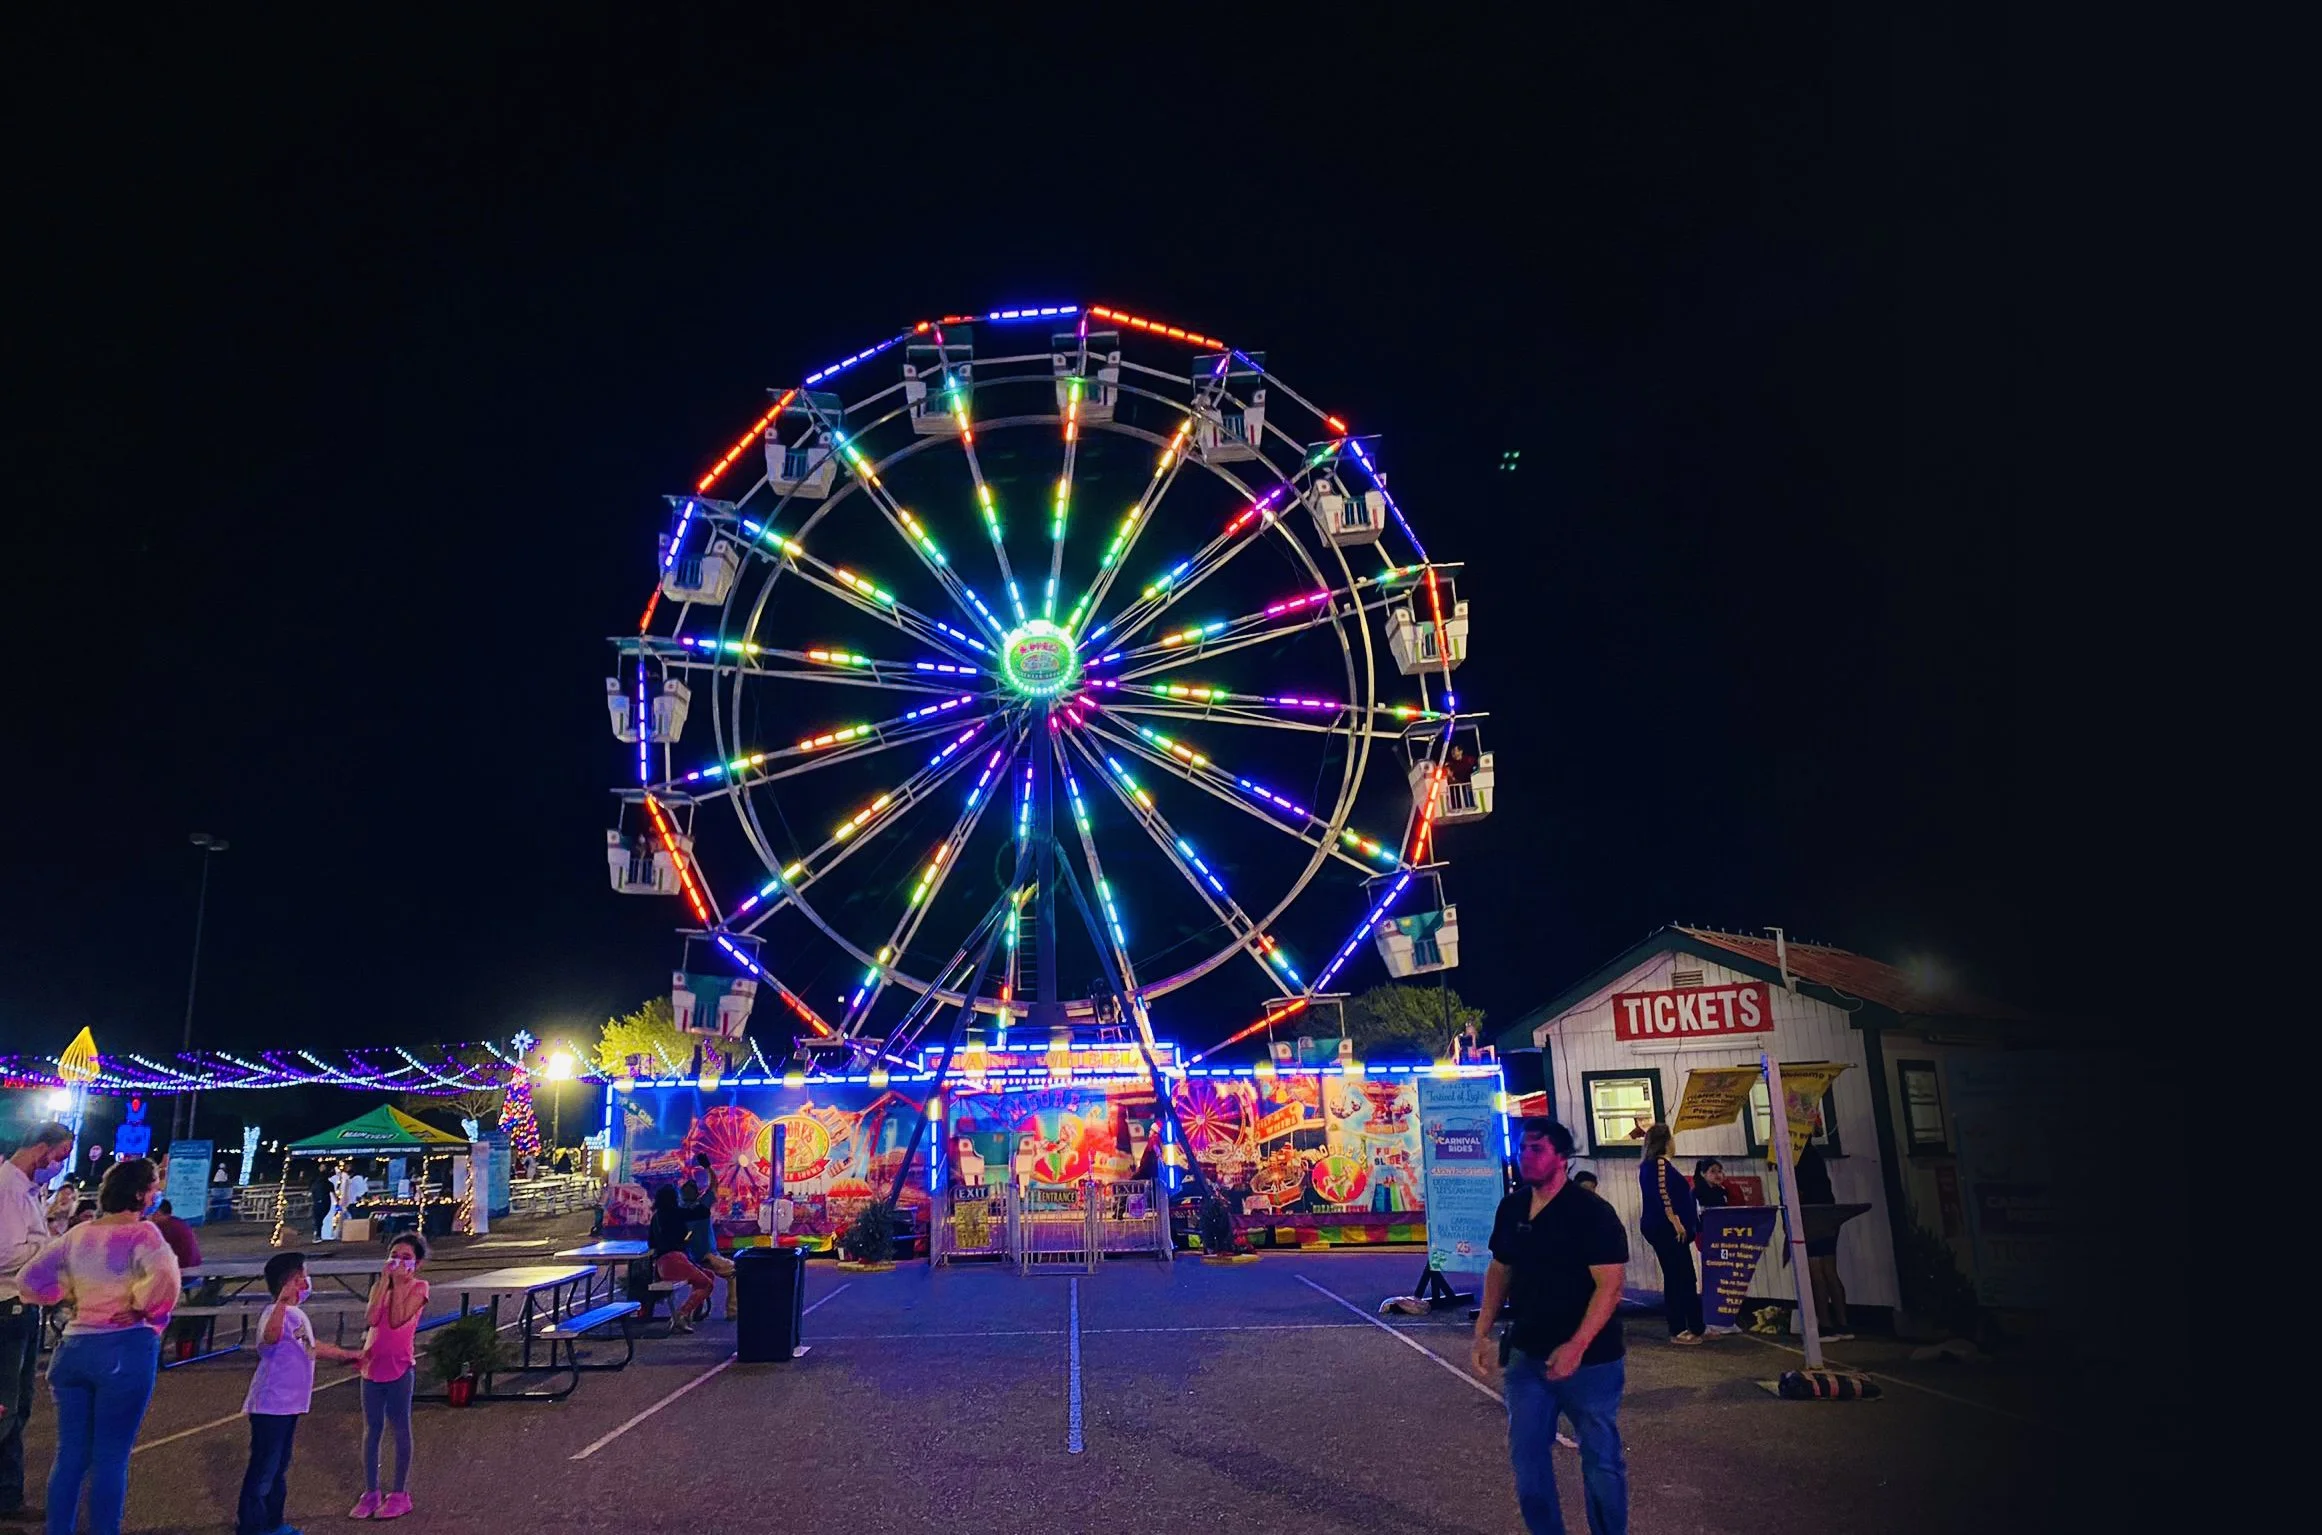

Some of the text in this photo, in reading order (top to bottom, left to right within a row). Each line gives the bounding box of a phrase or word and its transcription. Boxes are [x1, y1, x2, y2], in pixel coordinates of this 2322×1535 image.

[1623, 988, 1761, 1034] TICKETS
[1044, 1051, 1140, 1068] WHEEL
[1266, 1114, 1298, 1135] WHIRL
[1439, 1137, 1480, 1145] CARNIVAL
[1448, 1145, 1473, 1153] RIDES
[958, 1187, 987, 1199] EXIT
[1115, 1183, 1144, 1195] EXIT
[1041, 1191, 1076, 1202] ENTRANCE
[1722, 1227, 1753, 1237] FYI
